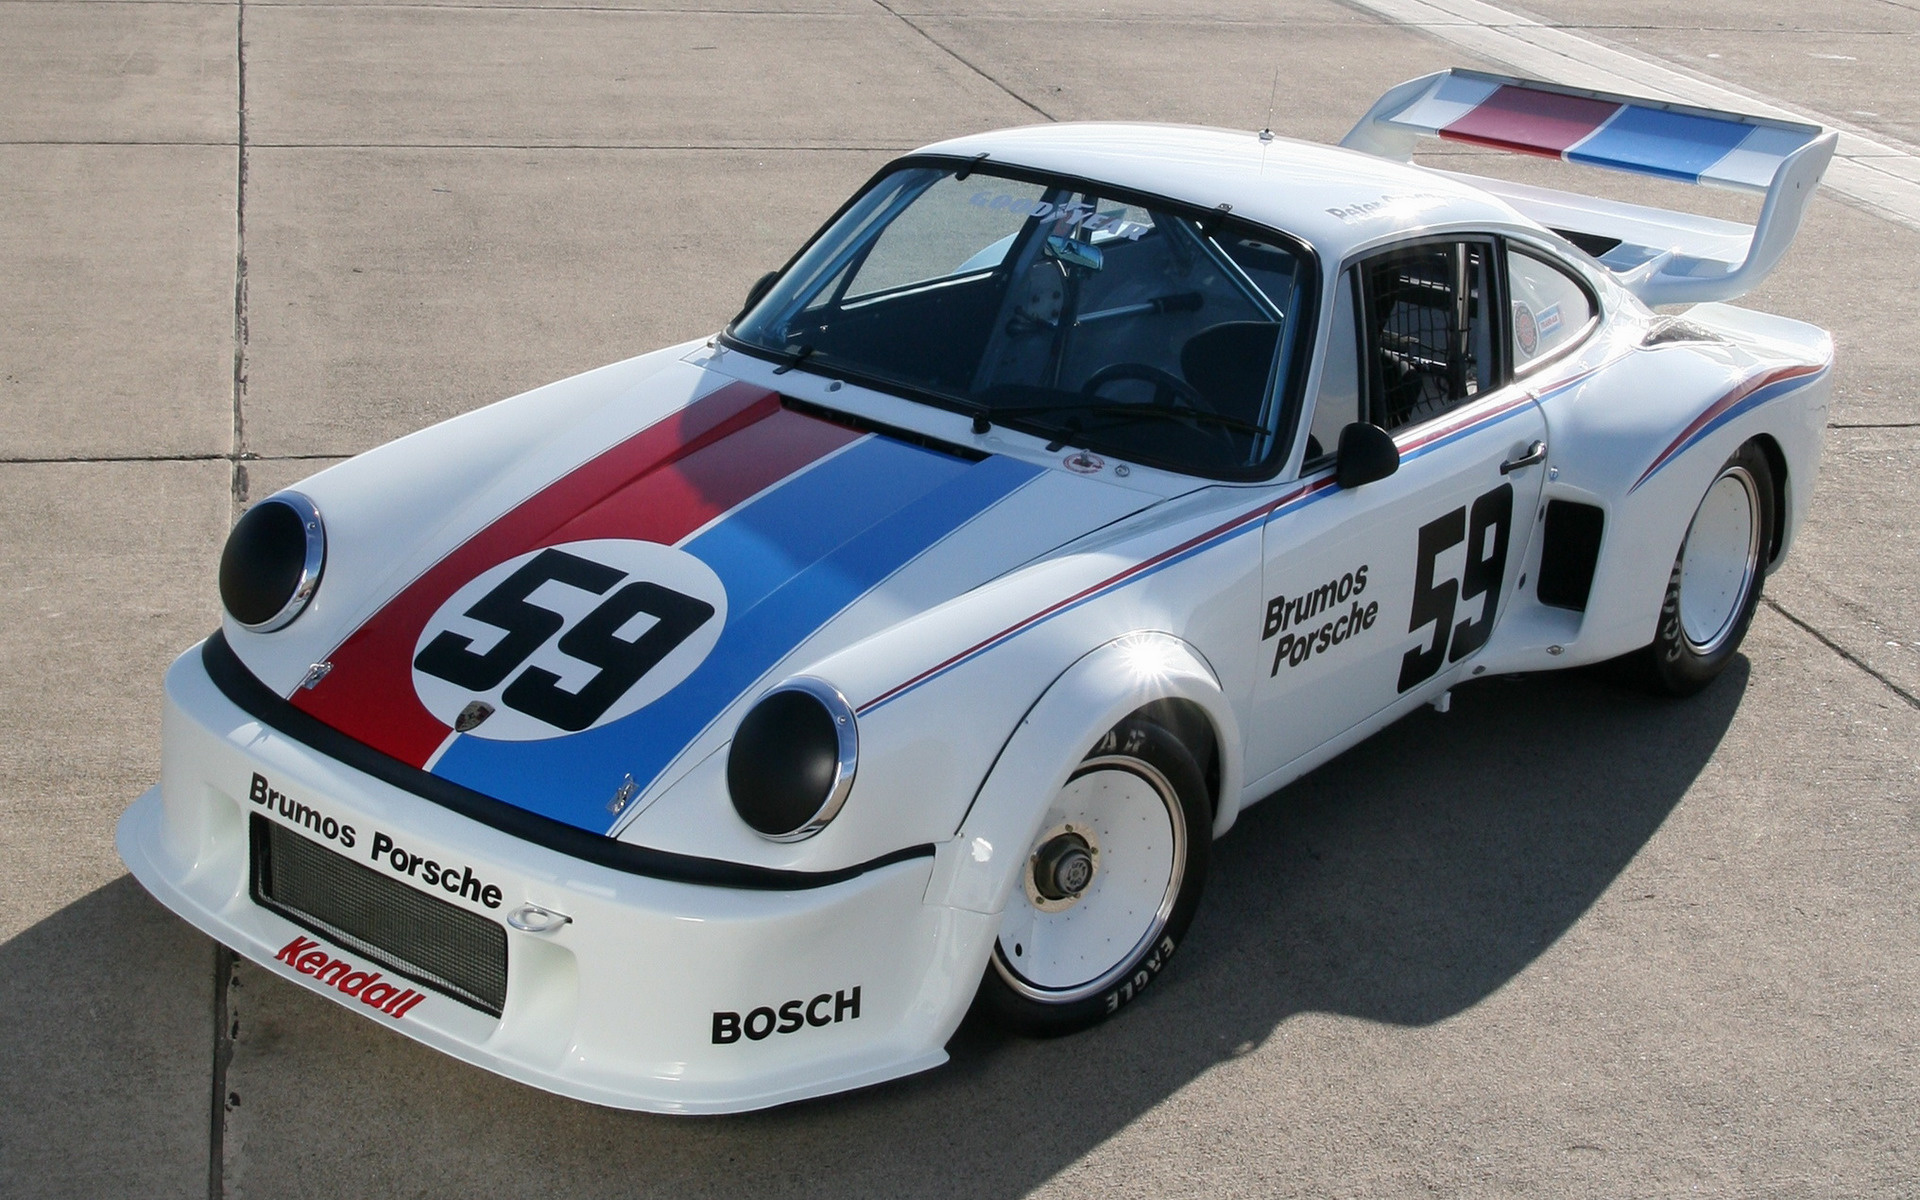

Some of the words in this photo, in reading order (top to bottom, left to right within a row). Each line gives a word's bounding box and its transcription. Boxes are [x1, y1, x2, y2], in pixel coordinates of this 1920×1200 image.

[969, 190, 1149, 241] GOODYEAR
[1261, 564, 1368, 641] Brumos
[1398, 482, 1514, 695] 59
[414, 547, 715, 731] 59
[1270, 600, 1379, 678] Porsche
[249, 771, 357, 848] Brumos
[370, 831, 503, 909] Porsche
[273, 935, 426, 1019] Kendall
[711, 985, 862, 1045] BOSCH
[1105, 935, 1175, 1015] EAGLE
